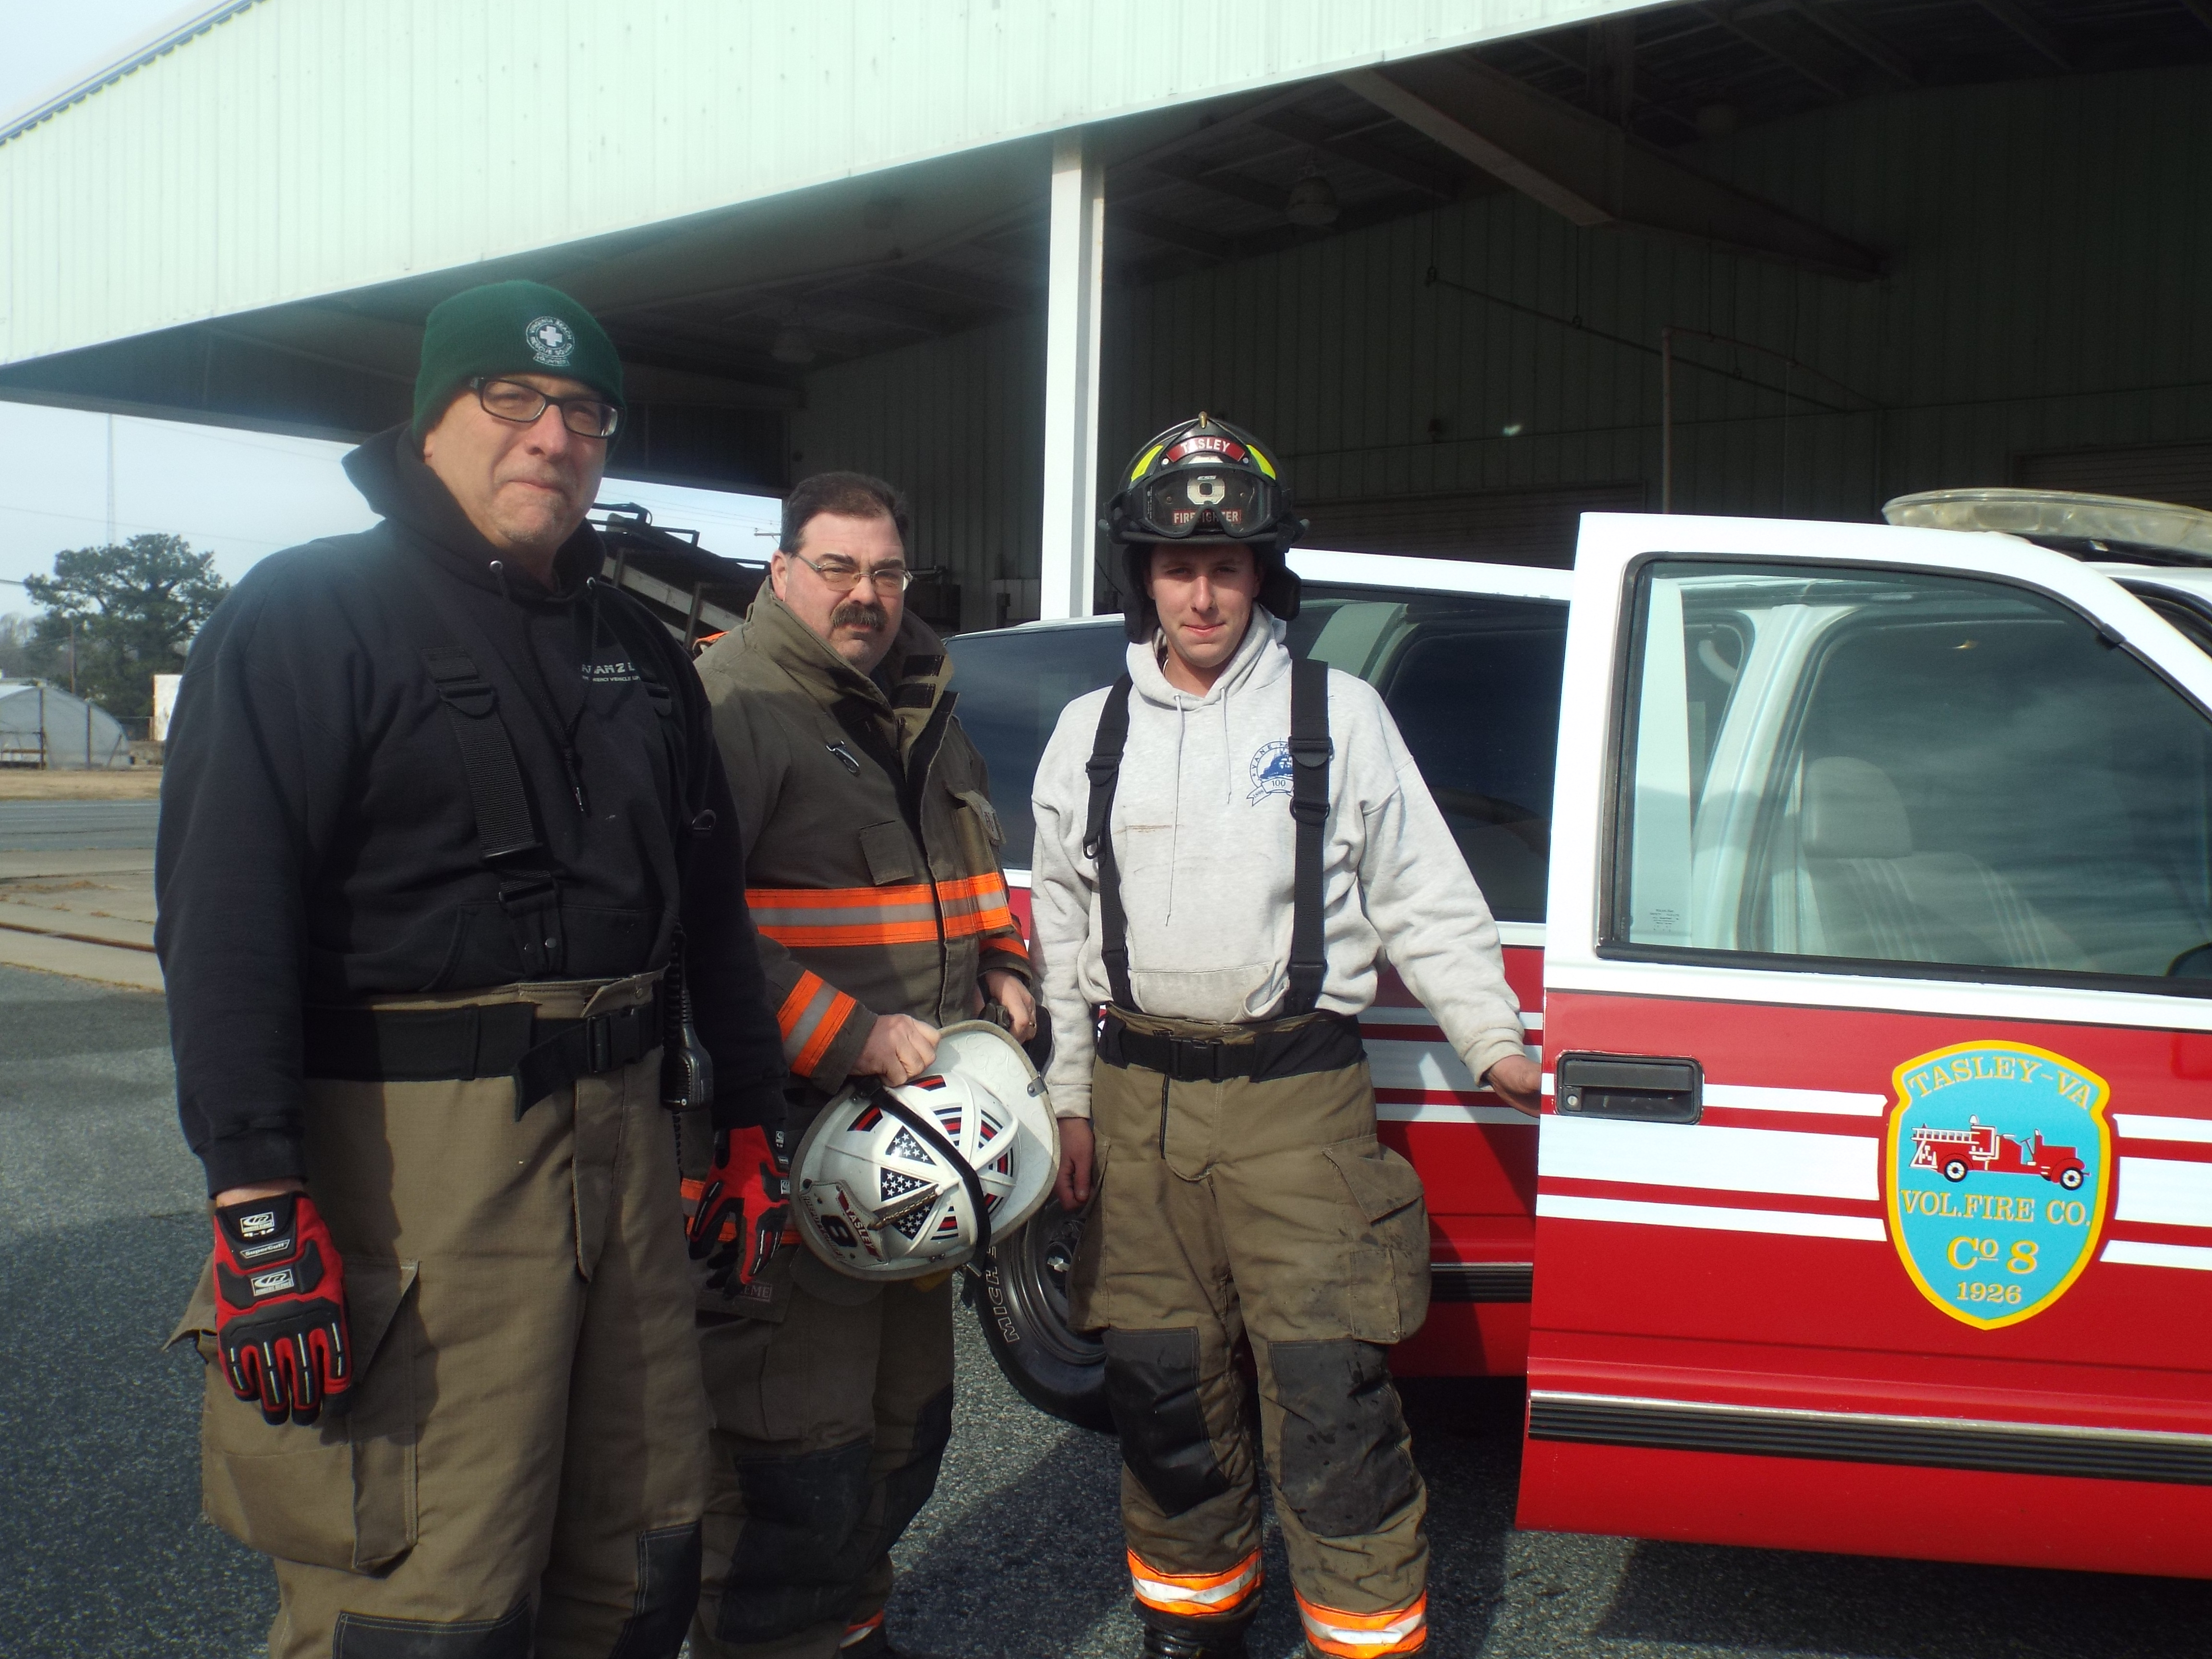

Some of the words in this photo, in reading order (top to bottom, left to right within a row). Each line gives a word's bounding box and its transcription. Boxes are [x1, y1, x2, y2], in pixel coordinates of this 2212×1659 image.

[1180, 438, 1231, 453] TASLEY
[1252, 744, 1272, 769] VANE
[2007, 1240, 2039, 1274] 8
[1956, 1282, 2022, 1305] 1926
